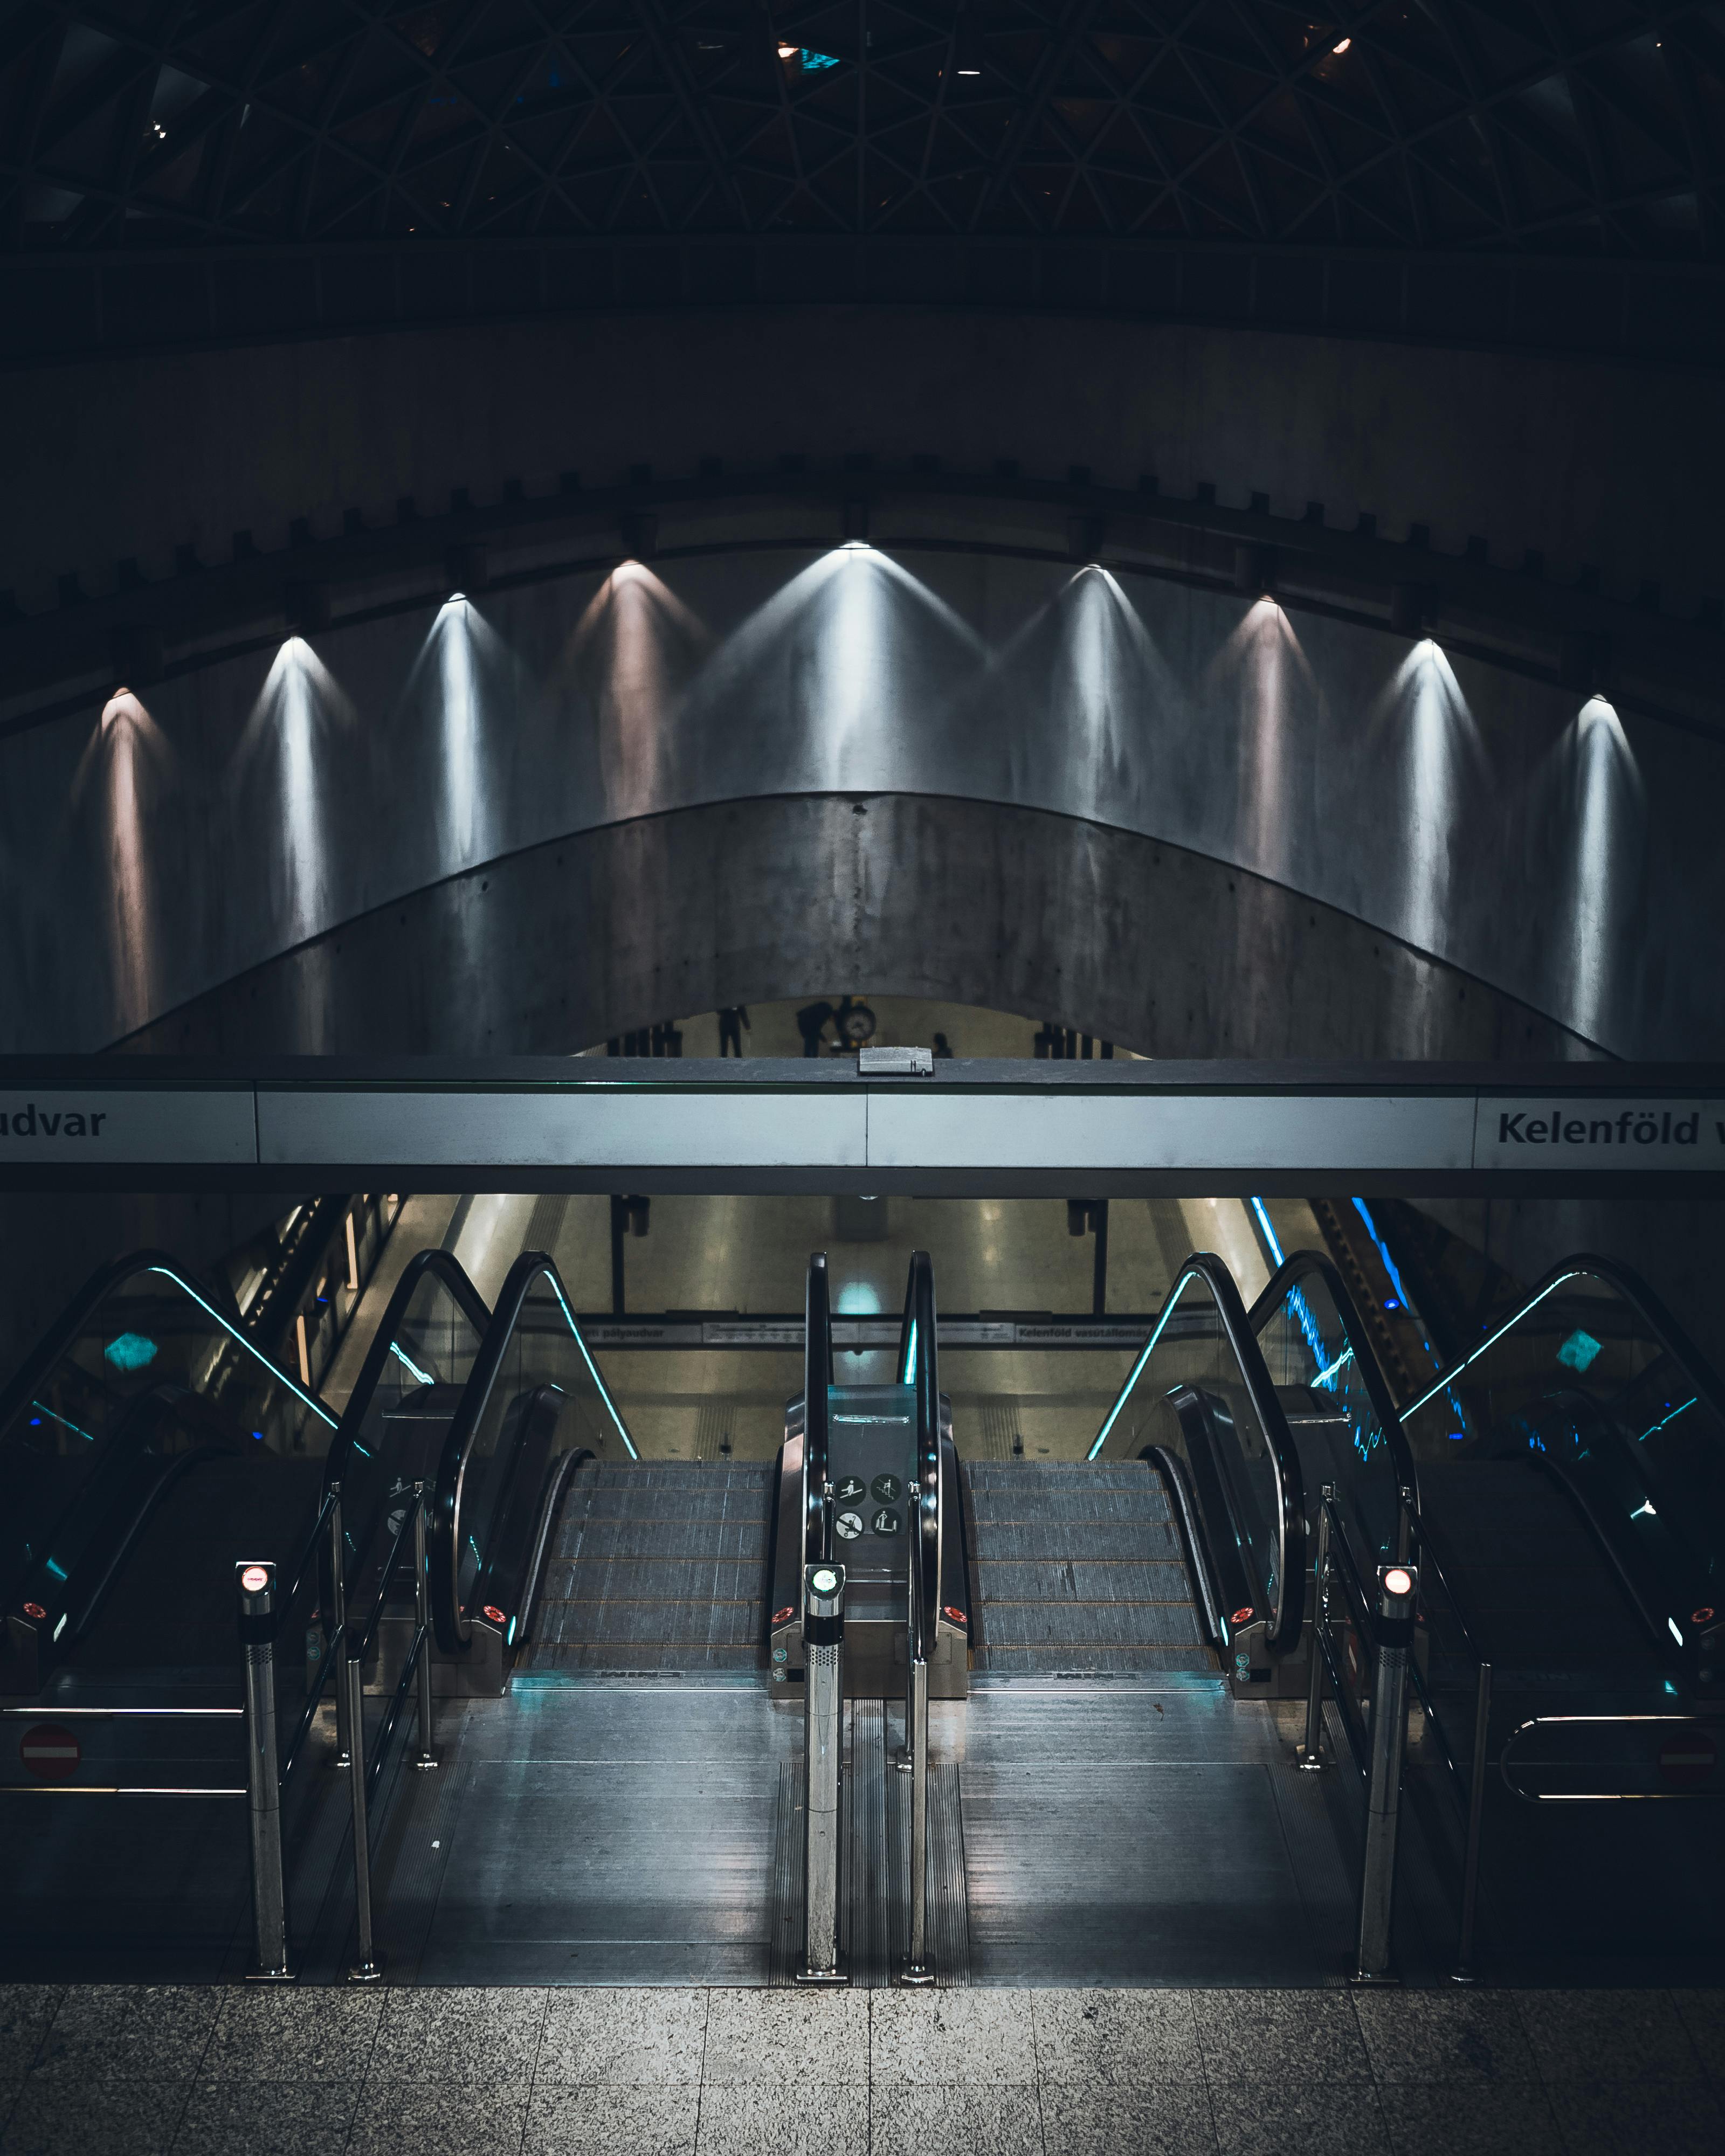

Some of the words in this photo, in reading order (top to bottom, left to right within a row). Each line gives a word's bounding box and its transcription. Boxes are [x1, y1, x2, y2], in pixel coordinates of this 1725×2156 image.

[1498, 1111, 1700, 1144] Kelenföld
[603, 1328, 664, 1339] pályaudvar
[1019, 1328, 1072, 1337] Kelenföld
